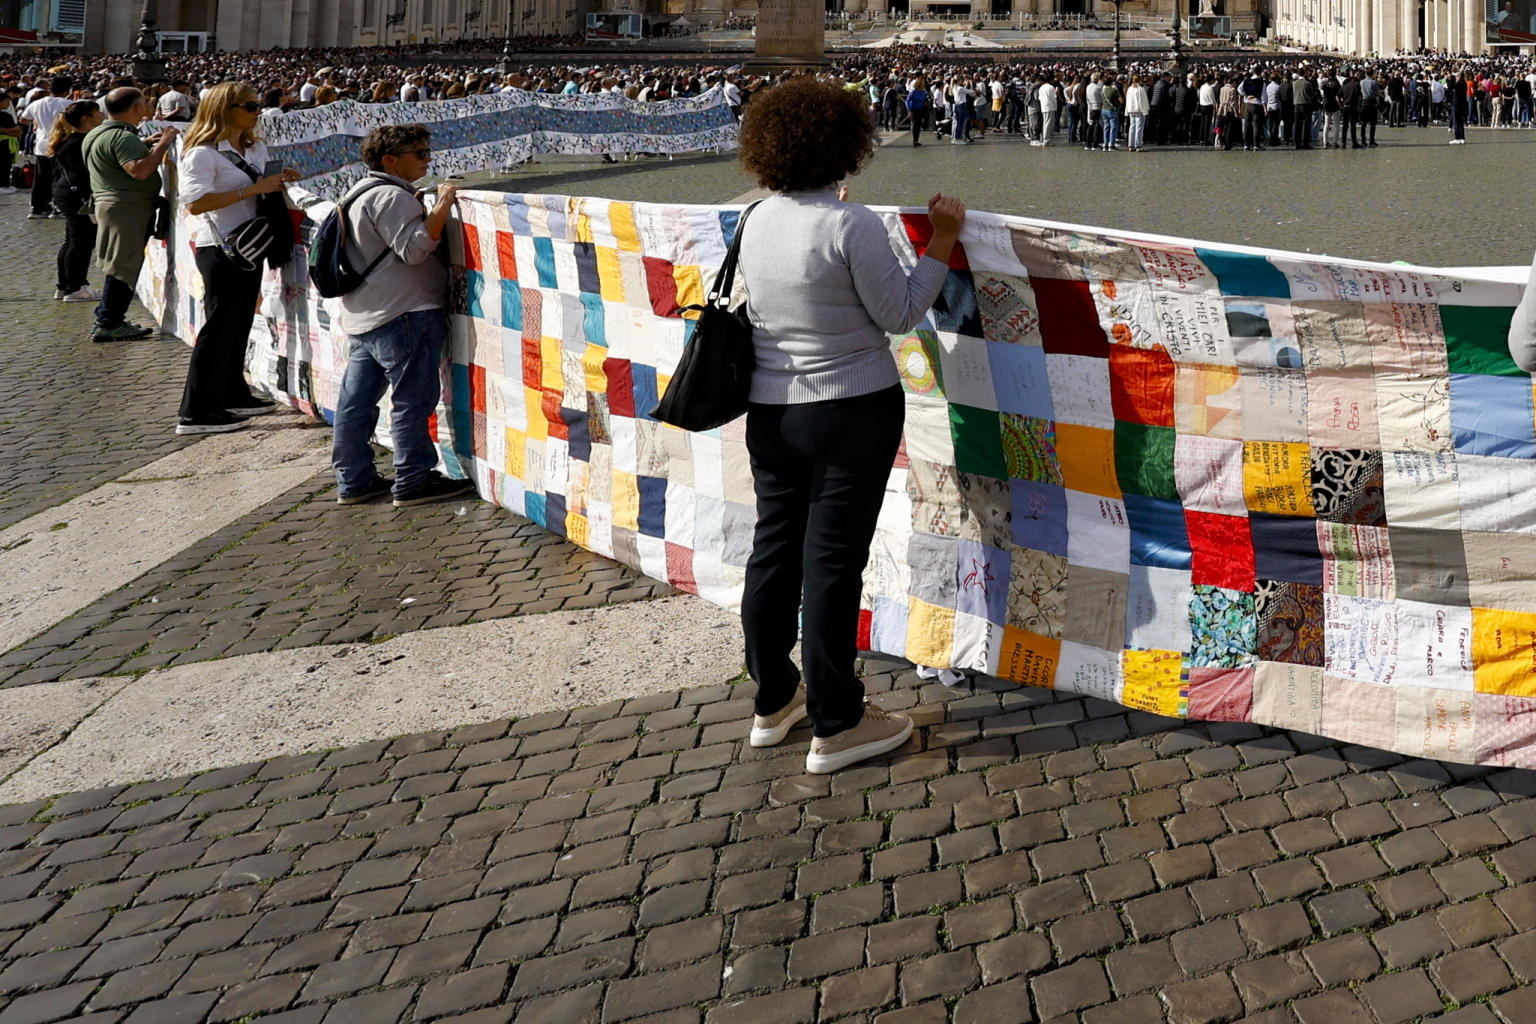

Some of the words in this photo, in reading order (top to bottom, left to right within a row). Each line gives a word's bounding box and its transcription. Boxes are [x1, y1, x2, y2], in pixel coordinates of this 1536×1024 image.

[1159, 295, 1168, 306] IN
[1208, 307, 1219, 324] PER
[1161, 312, 1182, 357] CRISTO
[1174, 309, 1191, 352] VIVENTI
[1188, 317, 1199, 344] VIVI
[1194, 301, 1209, 325] MIEI
[1202, 333, 1217, 357] CARI
[1426, 644, 1435, 677] MARCO
